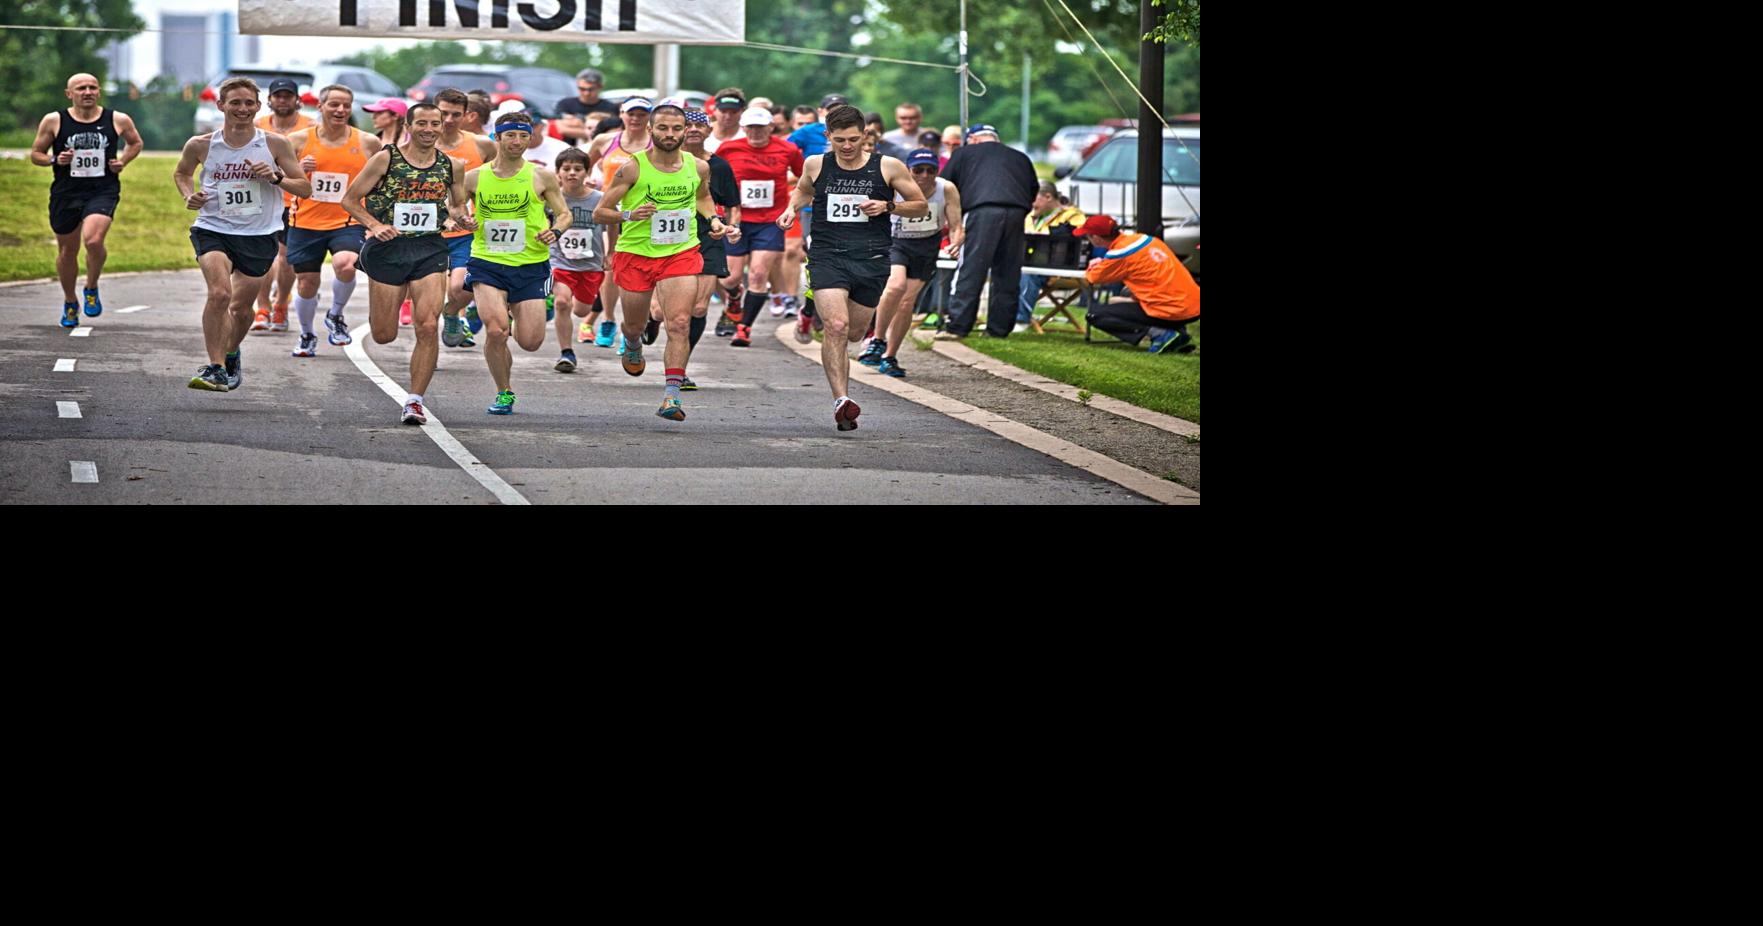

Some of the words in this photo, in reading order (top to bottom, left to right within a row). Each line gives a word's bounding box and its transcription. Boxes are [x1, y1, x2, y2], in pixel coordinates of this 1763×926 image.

[76, 156, 99, 168] 308
[224, 163, 249, 172] TUL
[316, 179, 341, 193] 319
[836, 179, 873, 187] TULSA
[746, 187, 768, 199] 281
[825, 186, 873, 195] RUNNER
[225, 190, 253, 205] 301
[832, 203, 860, 217] 295
[400, 212, 430, 227] 307
[658, 218, 685, 233] 318
[491, 229, 518, 242] 277
[564, 237, 587, 249] 294
